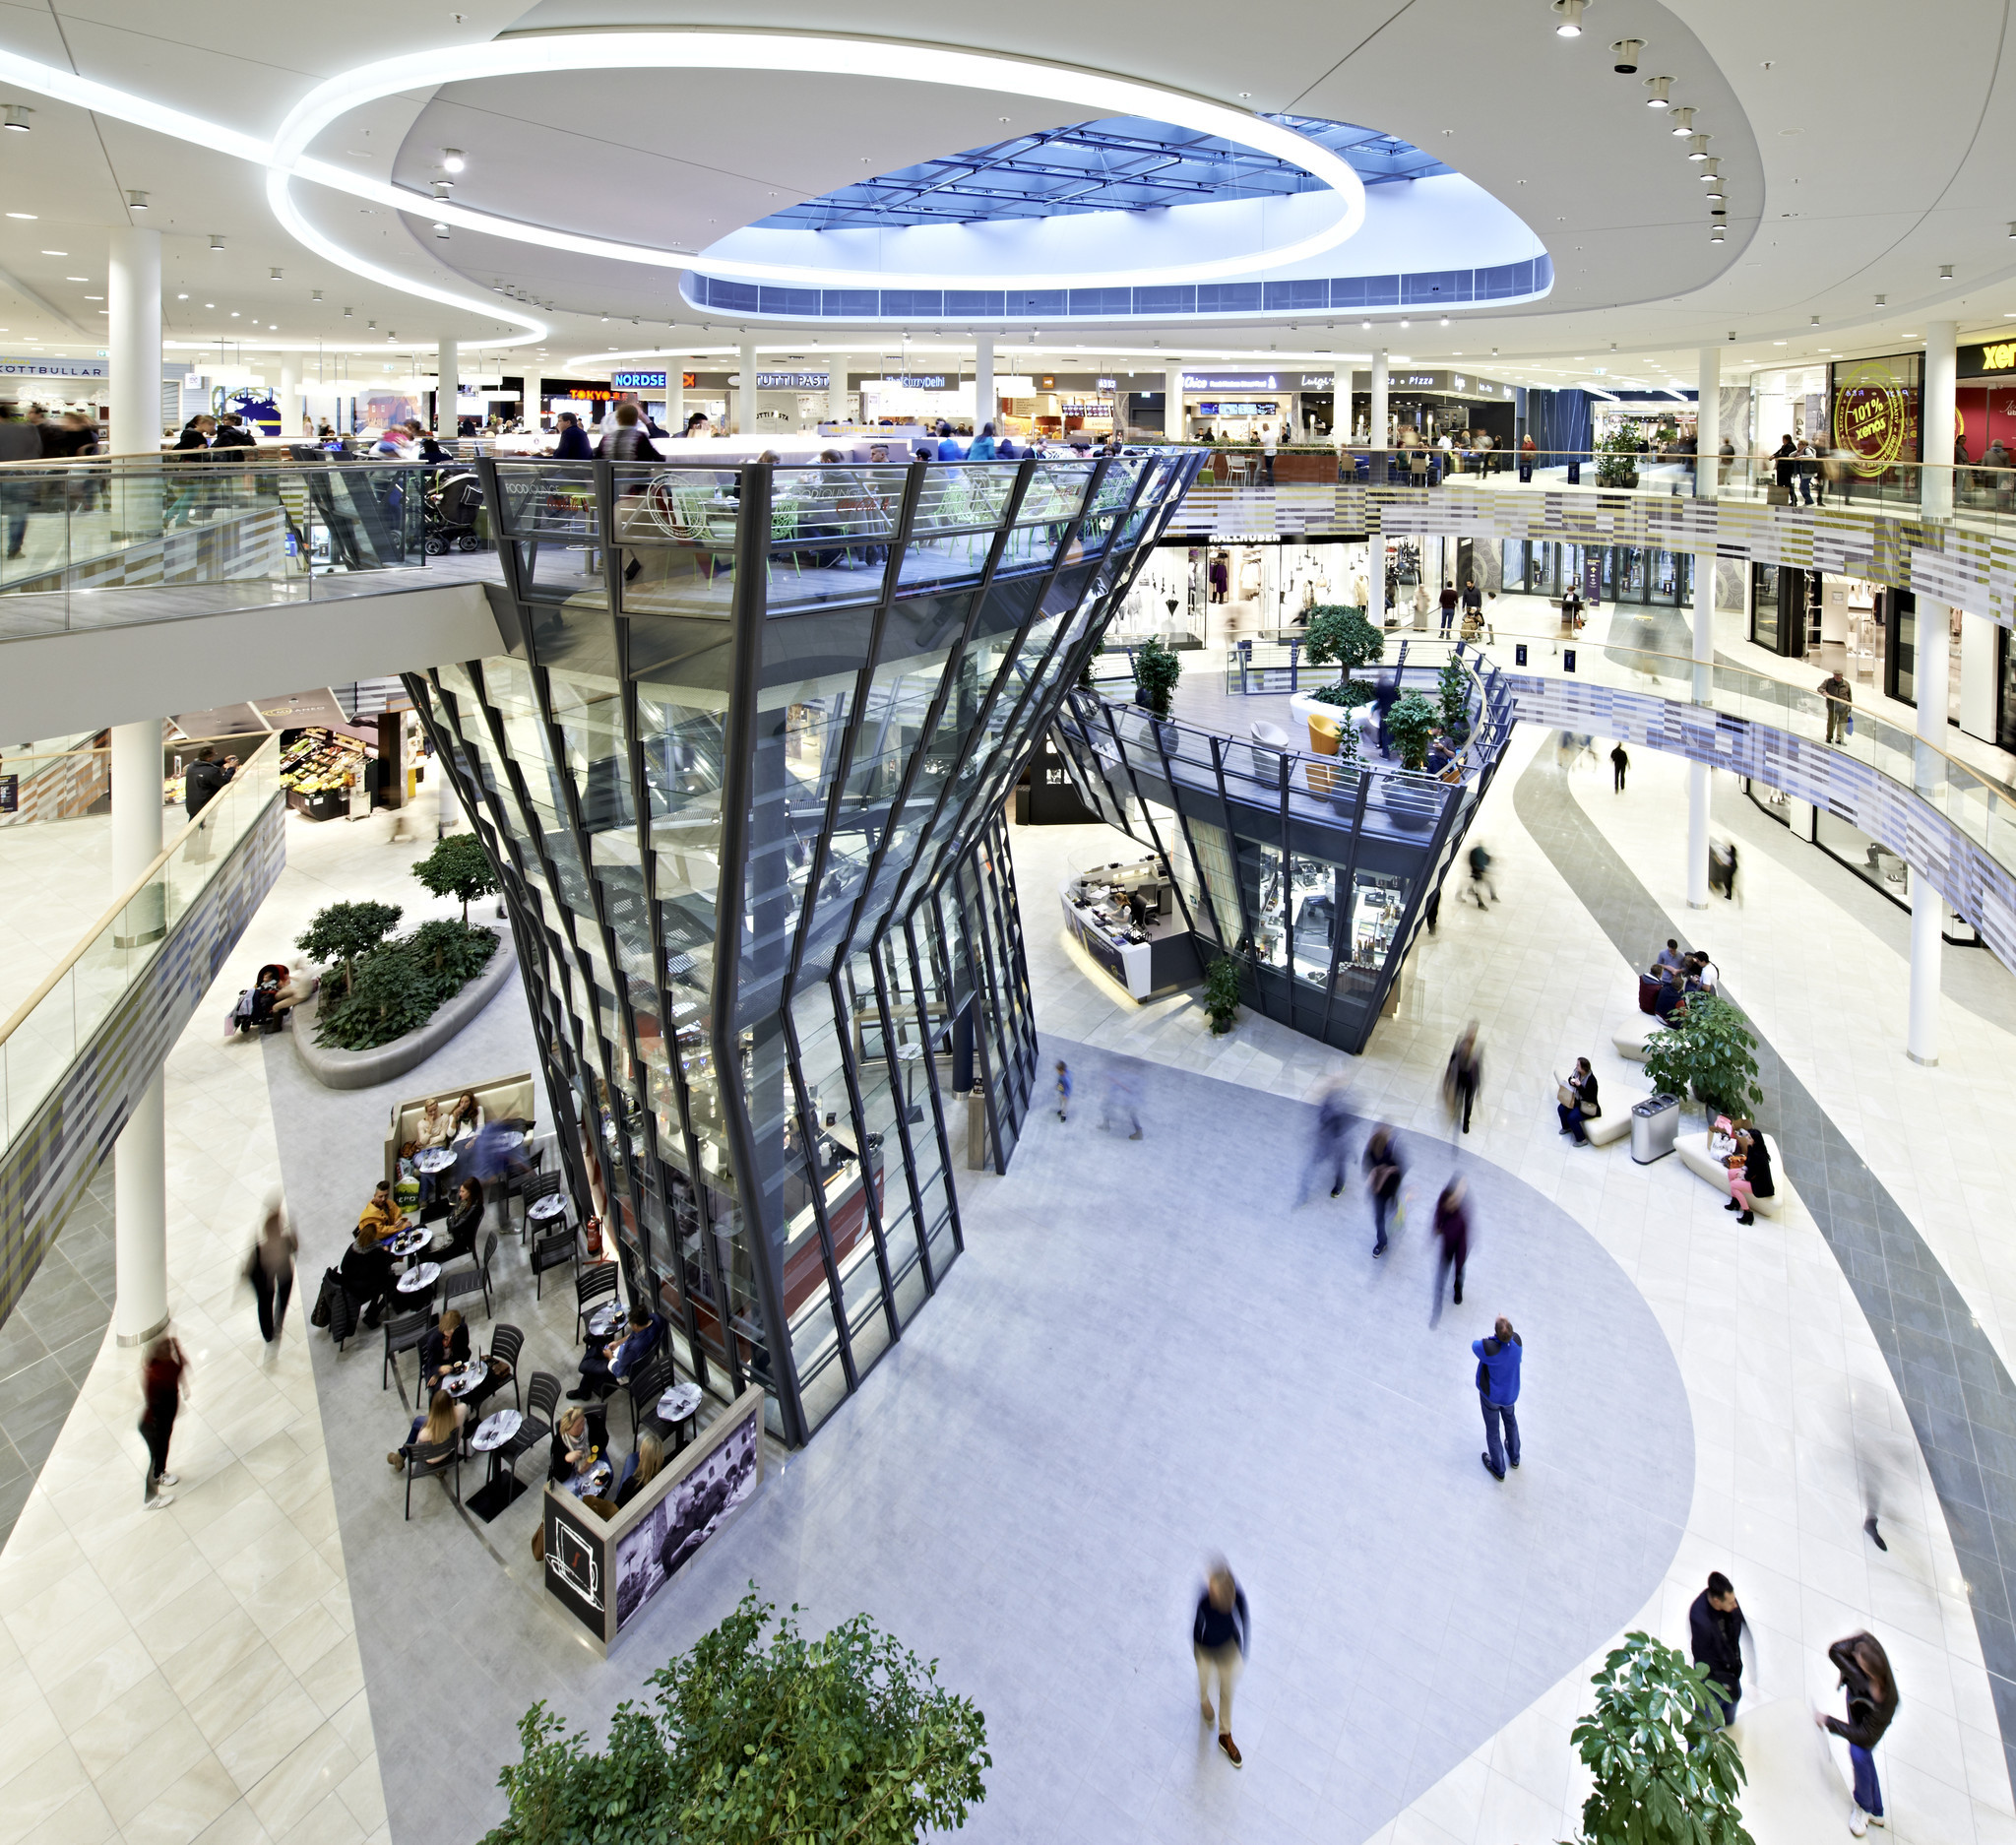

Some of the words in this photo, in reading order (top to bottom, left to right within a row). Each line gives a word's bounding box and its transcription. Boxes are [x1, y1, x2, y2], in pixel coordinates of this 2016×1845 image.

[615, 374, 666, 386] NORDSE
[797, 376, 829, 387] PAST
[570, 390, 611, 401] TOKYO
[1852, 397, 1884, 423] 101%
[771, 413, 789, 421] PSTA
[1855, 417, 1887, 441] xenos
